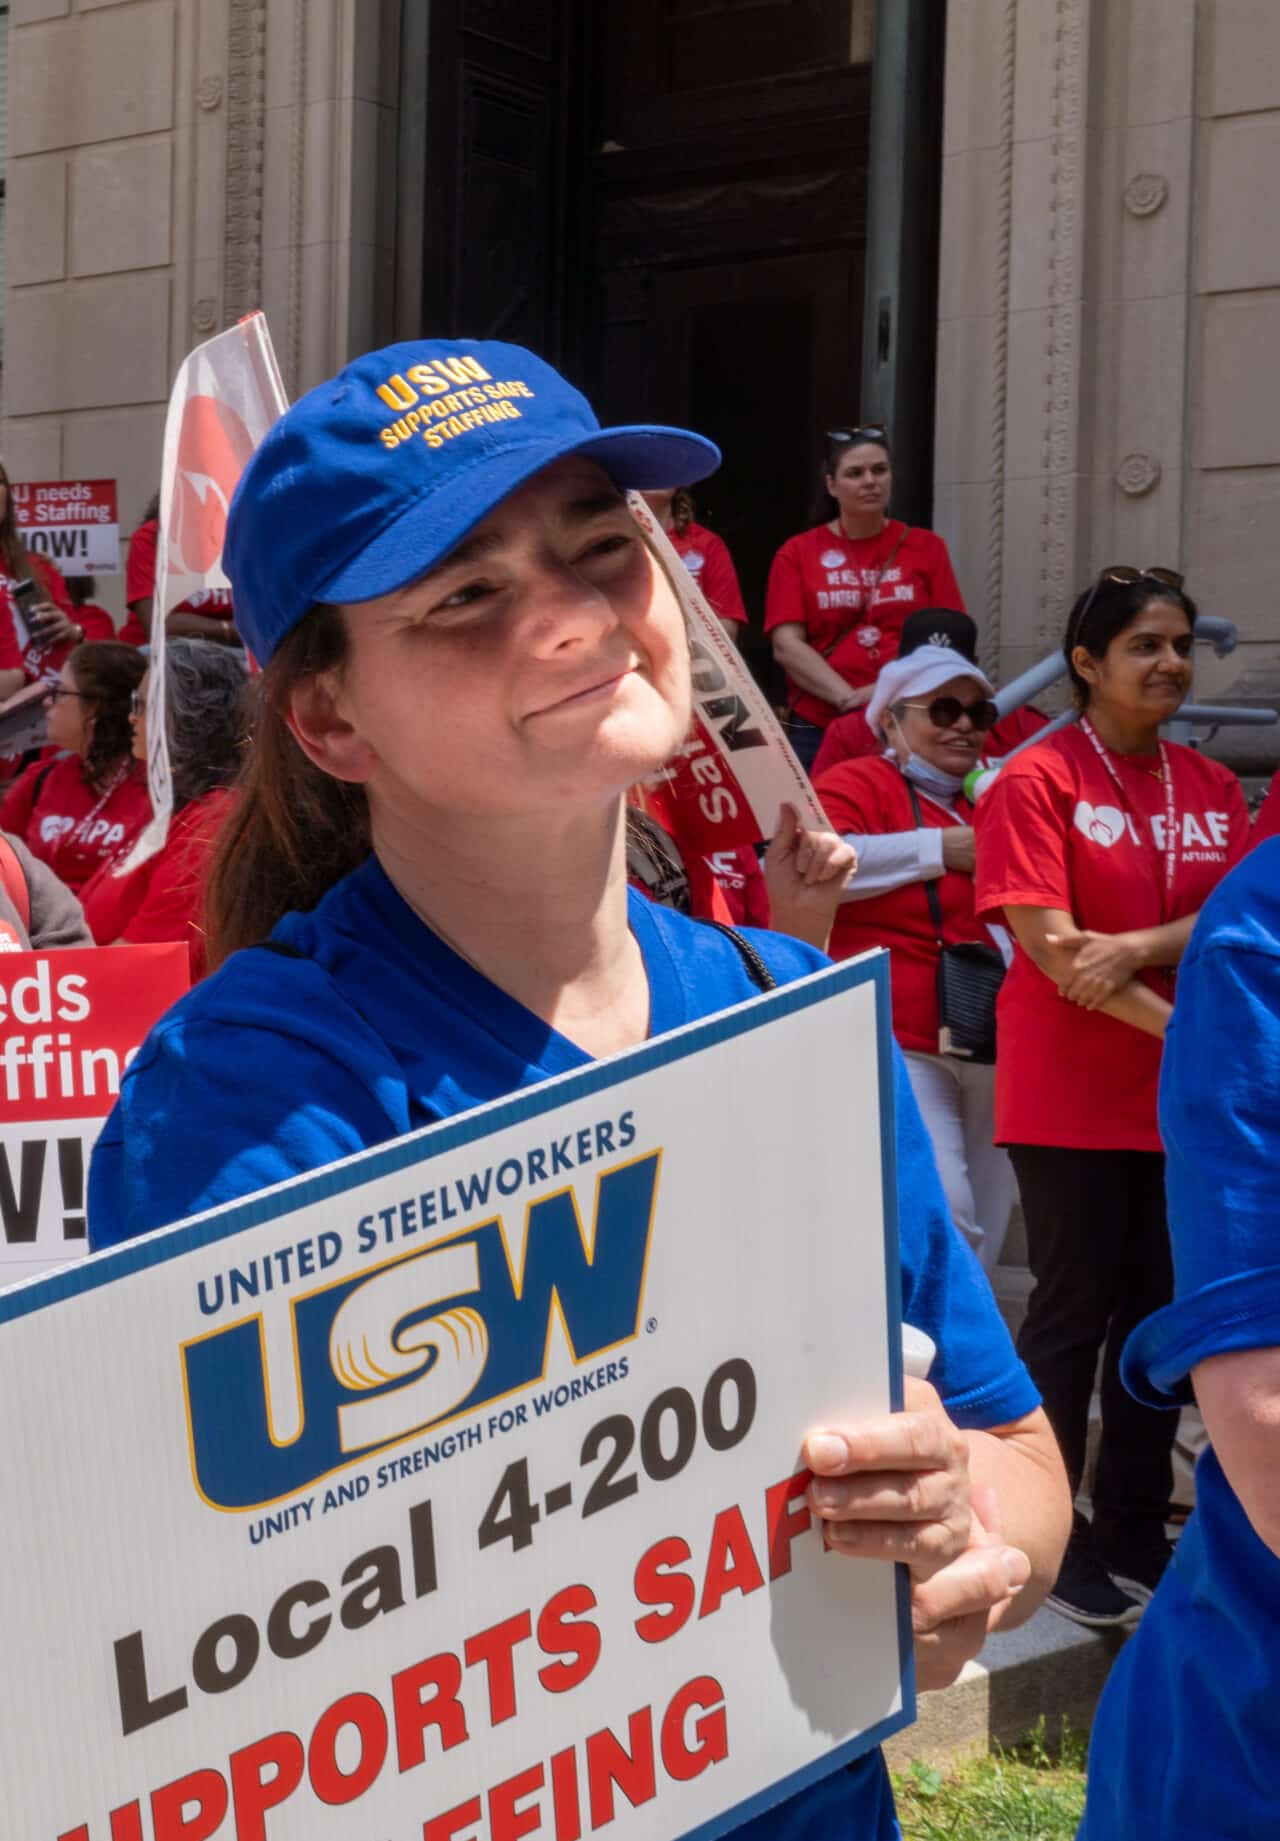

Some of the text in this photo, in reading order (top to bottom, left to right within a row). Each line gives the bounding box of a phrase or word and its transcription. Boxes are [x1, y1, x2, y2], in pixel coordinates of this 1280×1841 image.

[376, 356, 493, 411] USW
[379, 381, 535, 449] SUPPORTS SAFE
[423, 400, 522, 448] STAFFING
[35, 482, 92, 501] needs
[35, 502, 111, 522] Staffing
[197, 1111, 637, 1318] UNITED STEELWORKERS
[179, 1147, 663, 1514] USW
[248, 1356, 630, 1545] UNITY AND STRENGTH FOR WORKERS
[113, 1357, 758, 1736] Local 4-200
[634, 1469, 814, 1645] SAF
